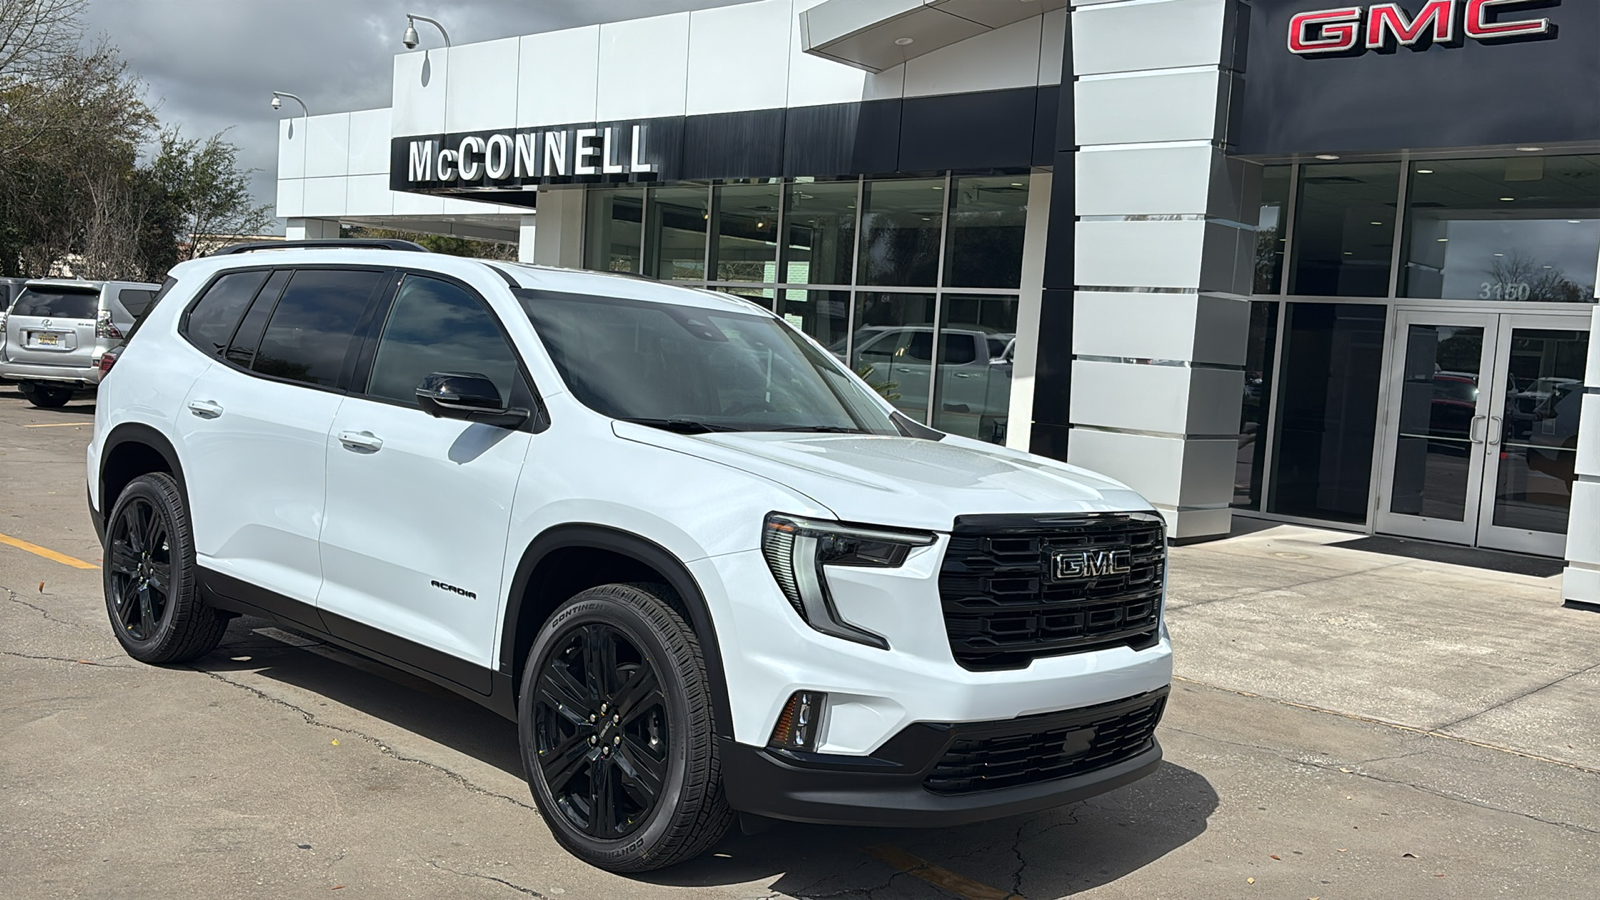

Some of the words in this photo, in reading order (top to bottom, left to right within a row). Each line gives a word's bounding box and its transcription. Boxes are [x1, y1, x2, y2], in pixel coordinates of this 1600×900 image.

[1287, 0, 1551, 54] GMC
[1479, 282, 1531, 300] 3150
[1056, 550, 1131, 578] GMC
[430, 580, 477, 600] ACADIA
